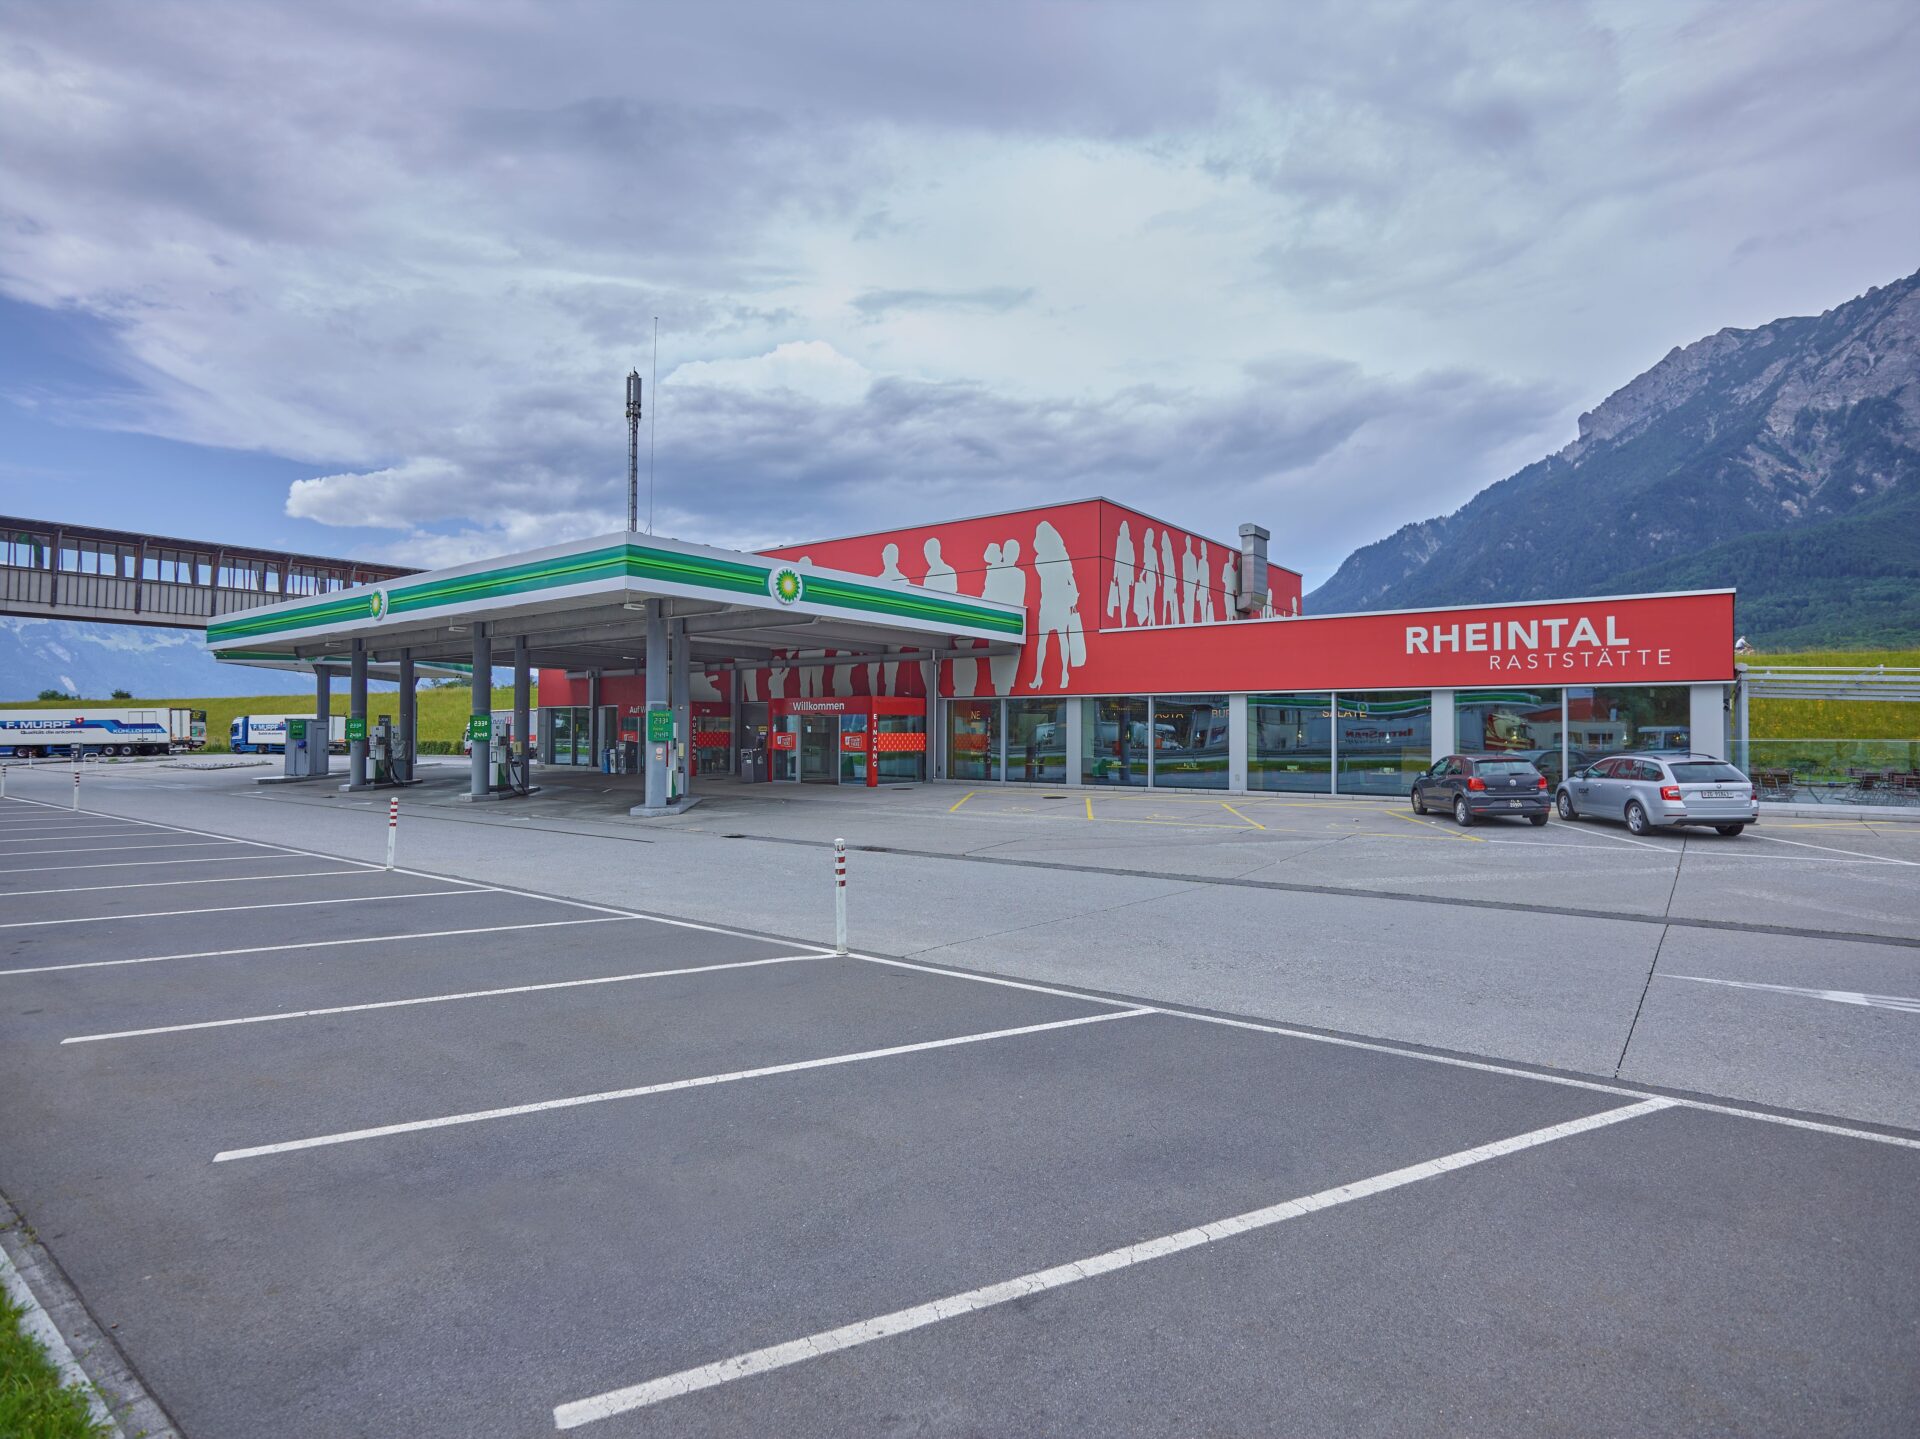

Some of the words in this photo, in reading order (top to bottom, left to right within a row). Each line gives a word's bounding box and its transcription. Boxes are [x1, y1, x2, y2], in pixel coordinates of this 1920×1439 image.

[1406, 616, 1630, 655] RHEINTAL
[1489, 648, 1672, 670] RASTSTÄTTE
[629, 705, 641, 714] Auf
[793, 702, 845, 711] Willkommen
[1322, 710, 1367, 718] SLATE
[6, 721, 18, 729] F.
[20, 721, 71, 729] MURPF
